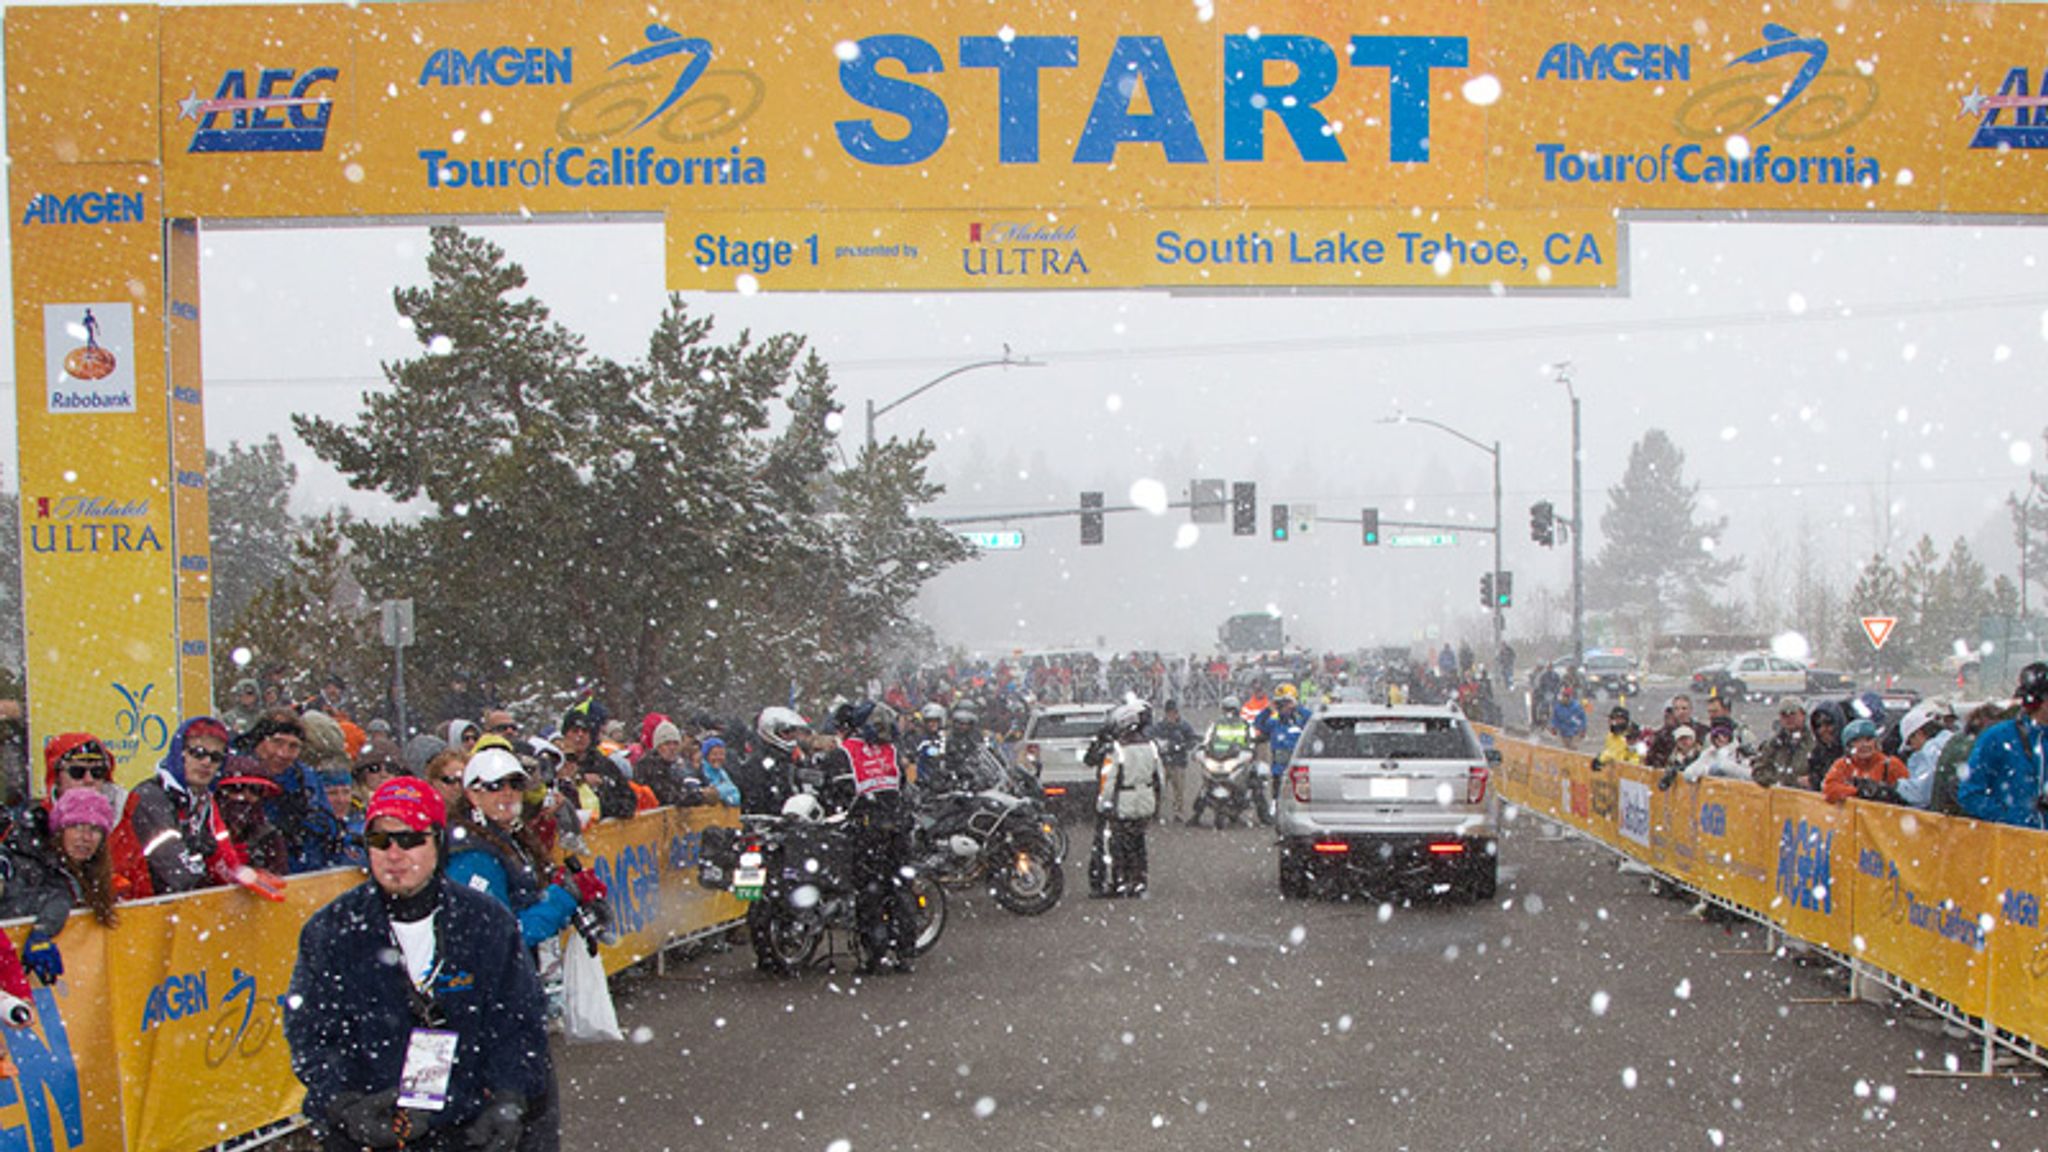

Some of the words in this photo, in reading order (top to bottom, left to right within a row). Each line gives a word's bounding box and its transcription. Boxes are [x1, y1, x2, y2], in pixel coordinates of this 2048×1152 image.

[419, 46, 573, 86] AMGEN
[1536, 41, 1690, 81] AMGEN
[190, 66, 339, 140] AEG
[834, 34, 1469, 166] START
[23, 191, 144, 225] AMGEN
[694, 234, 793, 274] Stage
[803, 234, 820, 266] 1
[962, 247, 1091, 276] ULTRA
[1155, 230, 1274, 265] South
[1289, 231, 1386, 265] Lake
[1397, 231, 1530, 271] Tahoe,
[1543, 232, 1603, 266] CA
[51, 390, 132, 408] Rabobank
[30, 524, 164, 553] ULTRA
